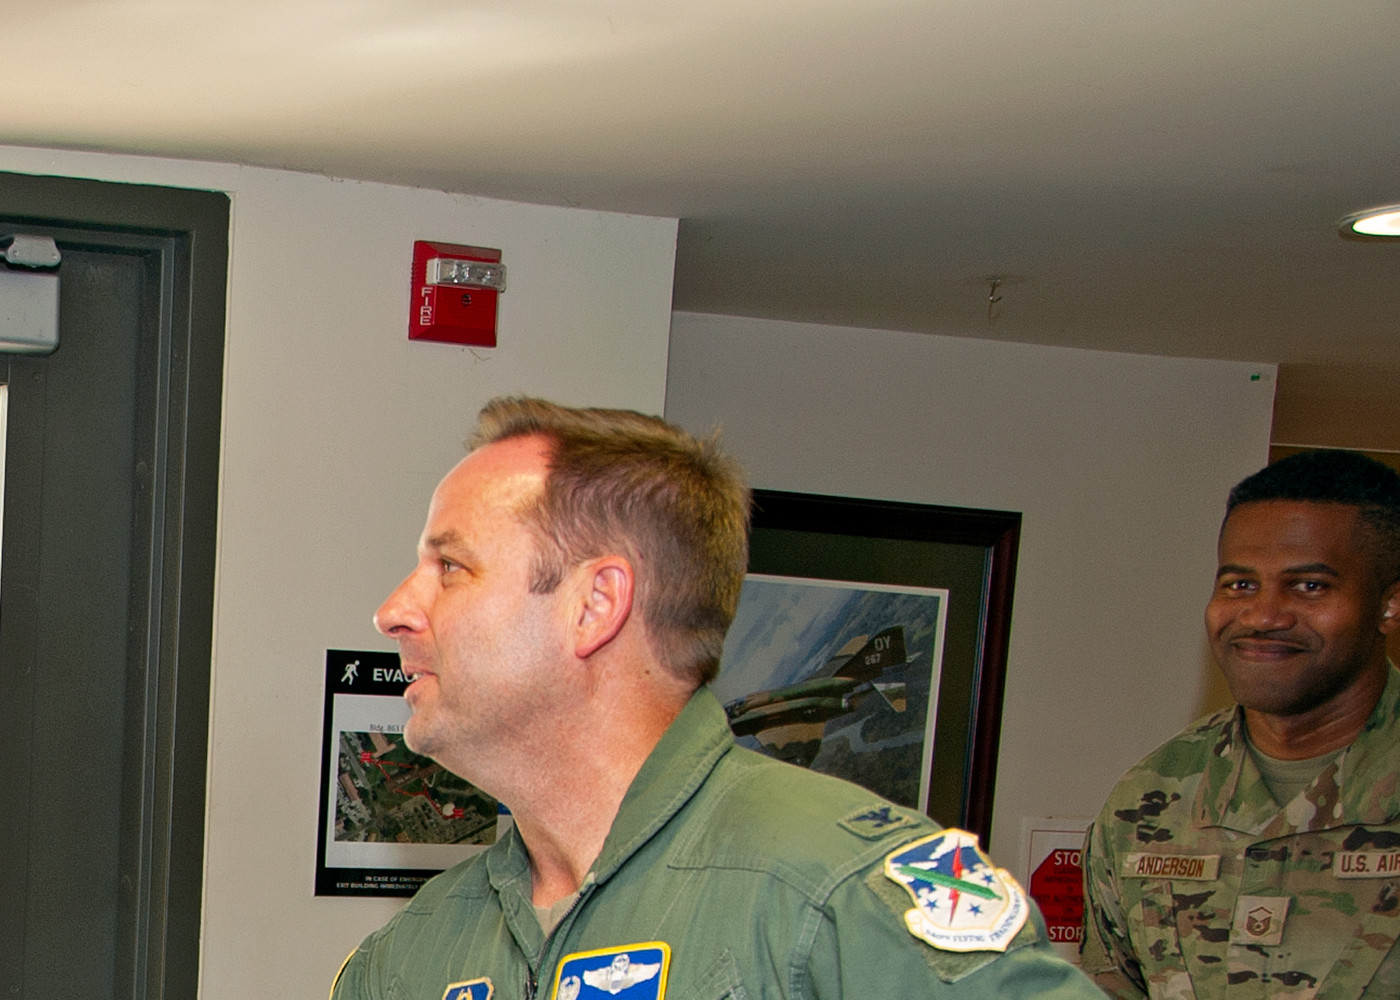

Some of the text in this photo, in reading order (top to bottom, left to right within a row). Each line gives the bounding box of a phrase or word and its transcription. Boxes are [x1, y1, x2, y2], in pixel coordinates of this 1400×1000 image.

[420, 287, 434, 326] FIRE
[1054, 852, 1080, 867] STO
[1136, 856, 1205, 877] ANDERSON
[1341, 854, 1370, 872] U.S.
